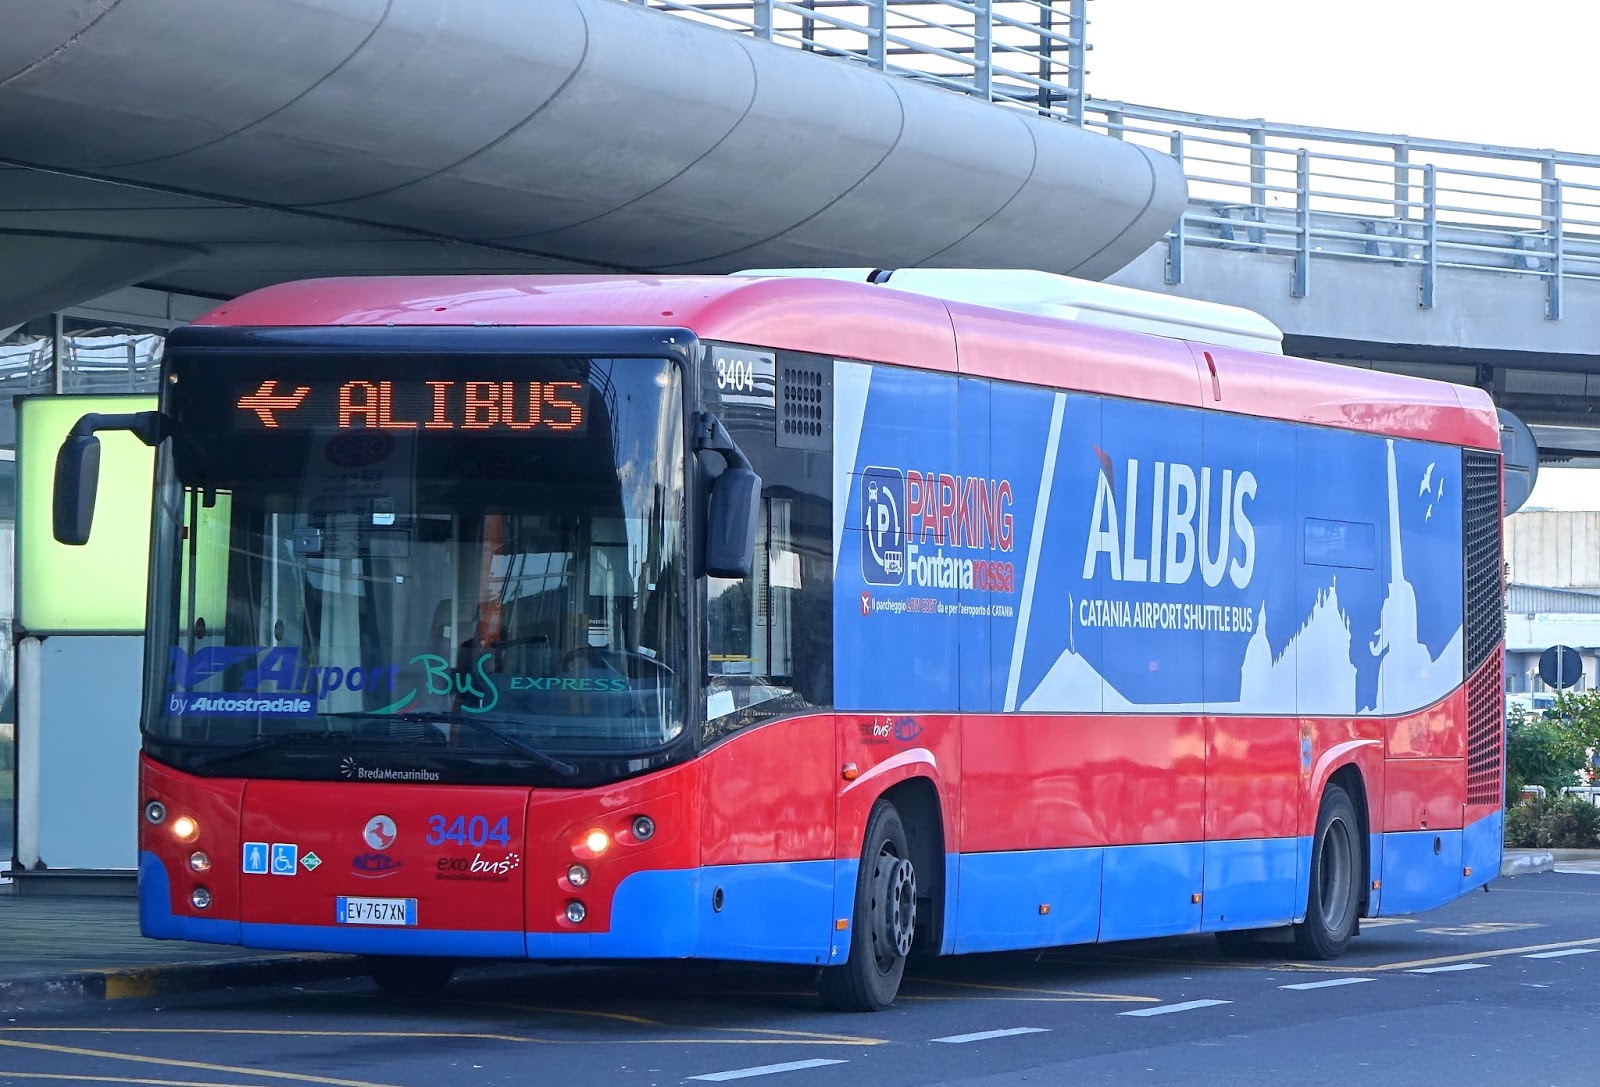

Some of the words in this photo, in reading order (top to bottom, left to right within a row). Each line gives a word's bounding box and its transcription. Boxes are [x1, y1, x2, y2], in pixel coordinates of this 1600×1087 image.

[718, 358, 753, 392] 3404
[339, 380, 582, 429] ALIBUS
[906, 470, 1014, 552] PARKING
[1083, 459, 1258, 589] ALIBUS
[876, 598, 906, 614] parcheggio
[921, 598, 937, 613] COST
[937, 601, 944, 613] da
[949, 605, 957, 616] per
[992, 605, 1013, 617] CATANIA
[1079, 599, 1132, 628] CATANIA
[1133, 602, 1182, 630] AIRPORT
[1183, 604, 1230, 632] SHUTTLE
[1232, 607, 1253, 633] BUS
[241, 646, 400, 699] Airport
[510, 677, 626, 691] EXPRESS
[170, 695, 188, 713] by
[190, 697, 311, 713] Autostradale
[358, 767, 440, 780] BredaMenarinibus
[426, 814, 510, 847] 3404
